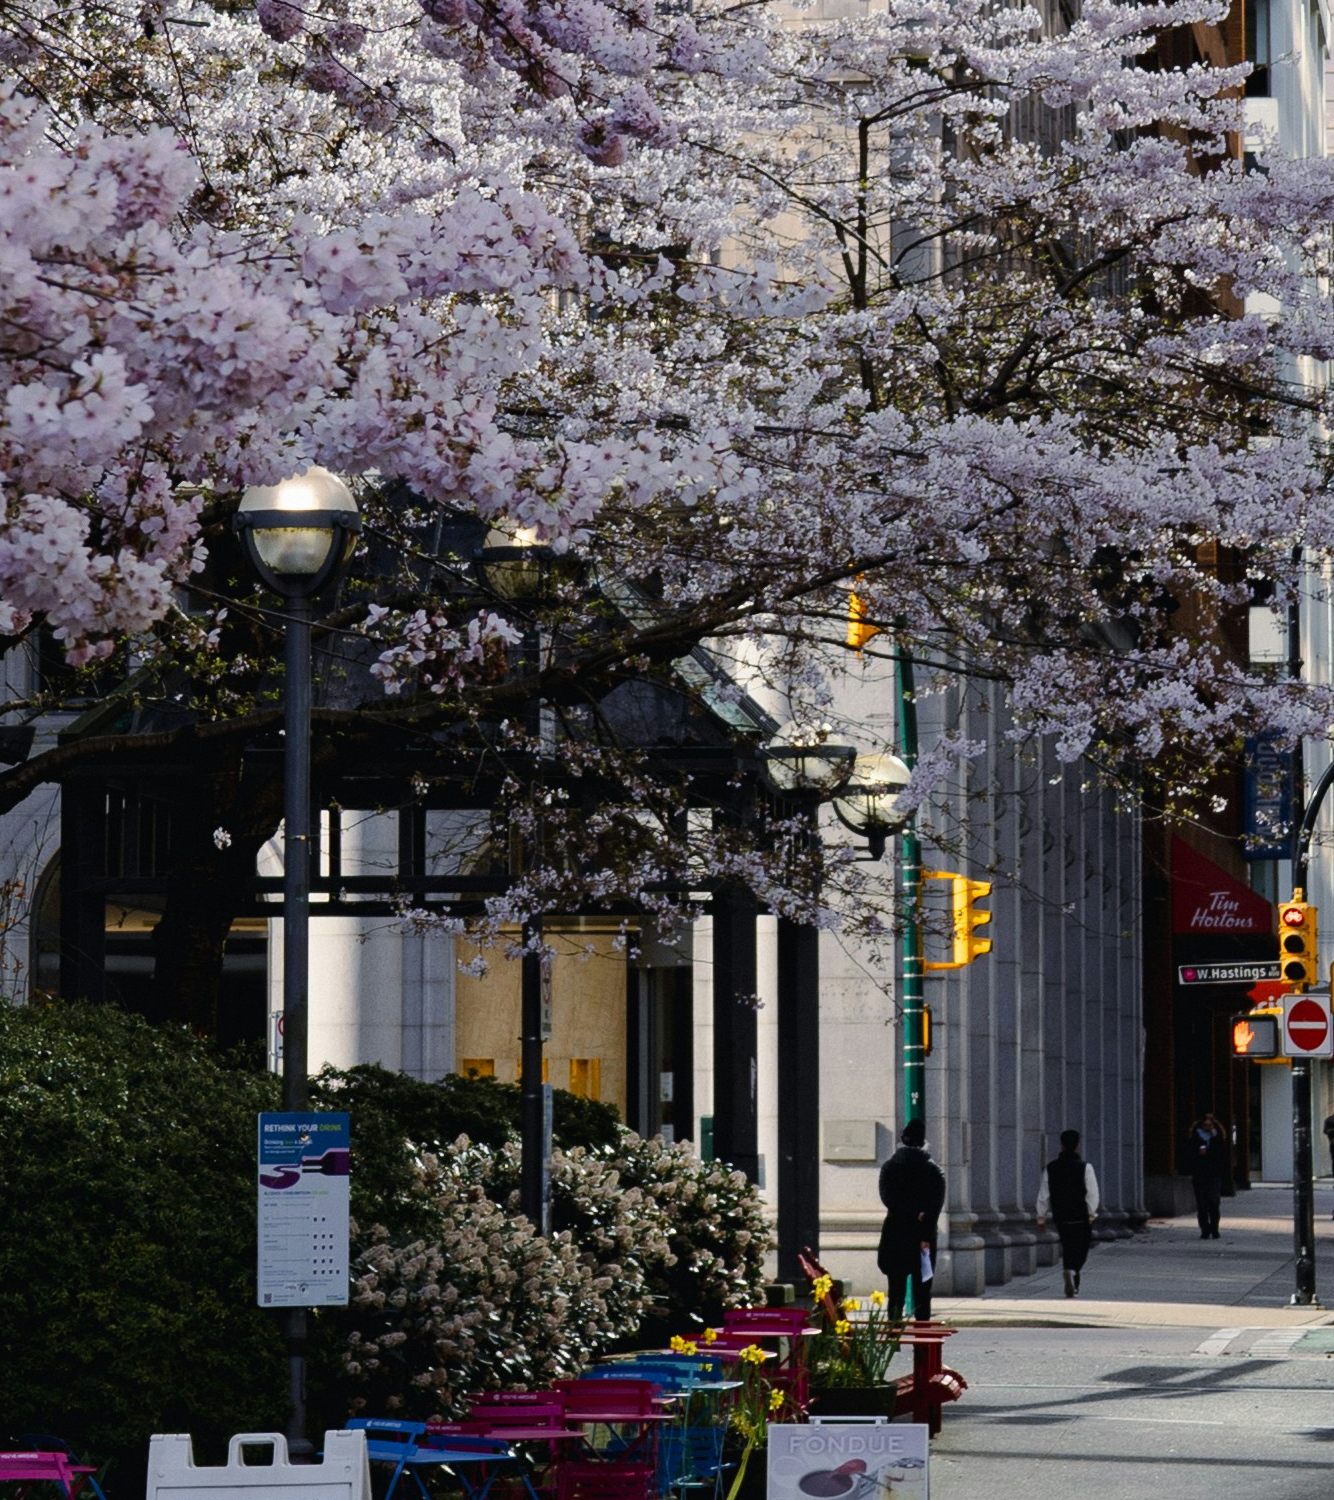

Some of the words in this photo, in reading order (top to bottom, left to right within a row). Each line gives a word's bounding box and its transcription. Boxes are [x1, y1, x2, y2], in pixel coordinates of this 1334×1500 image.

[1209, 891, 1240, 911] Tim
[1190, 908, 1253, 928] Hortons
[264, 1124, 296, 1133] RETHINK
[297, 1124, 319, 1132] YOUR
[789, 1436, 904, 1454] FONDUE
